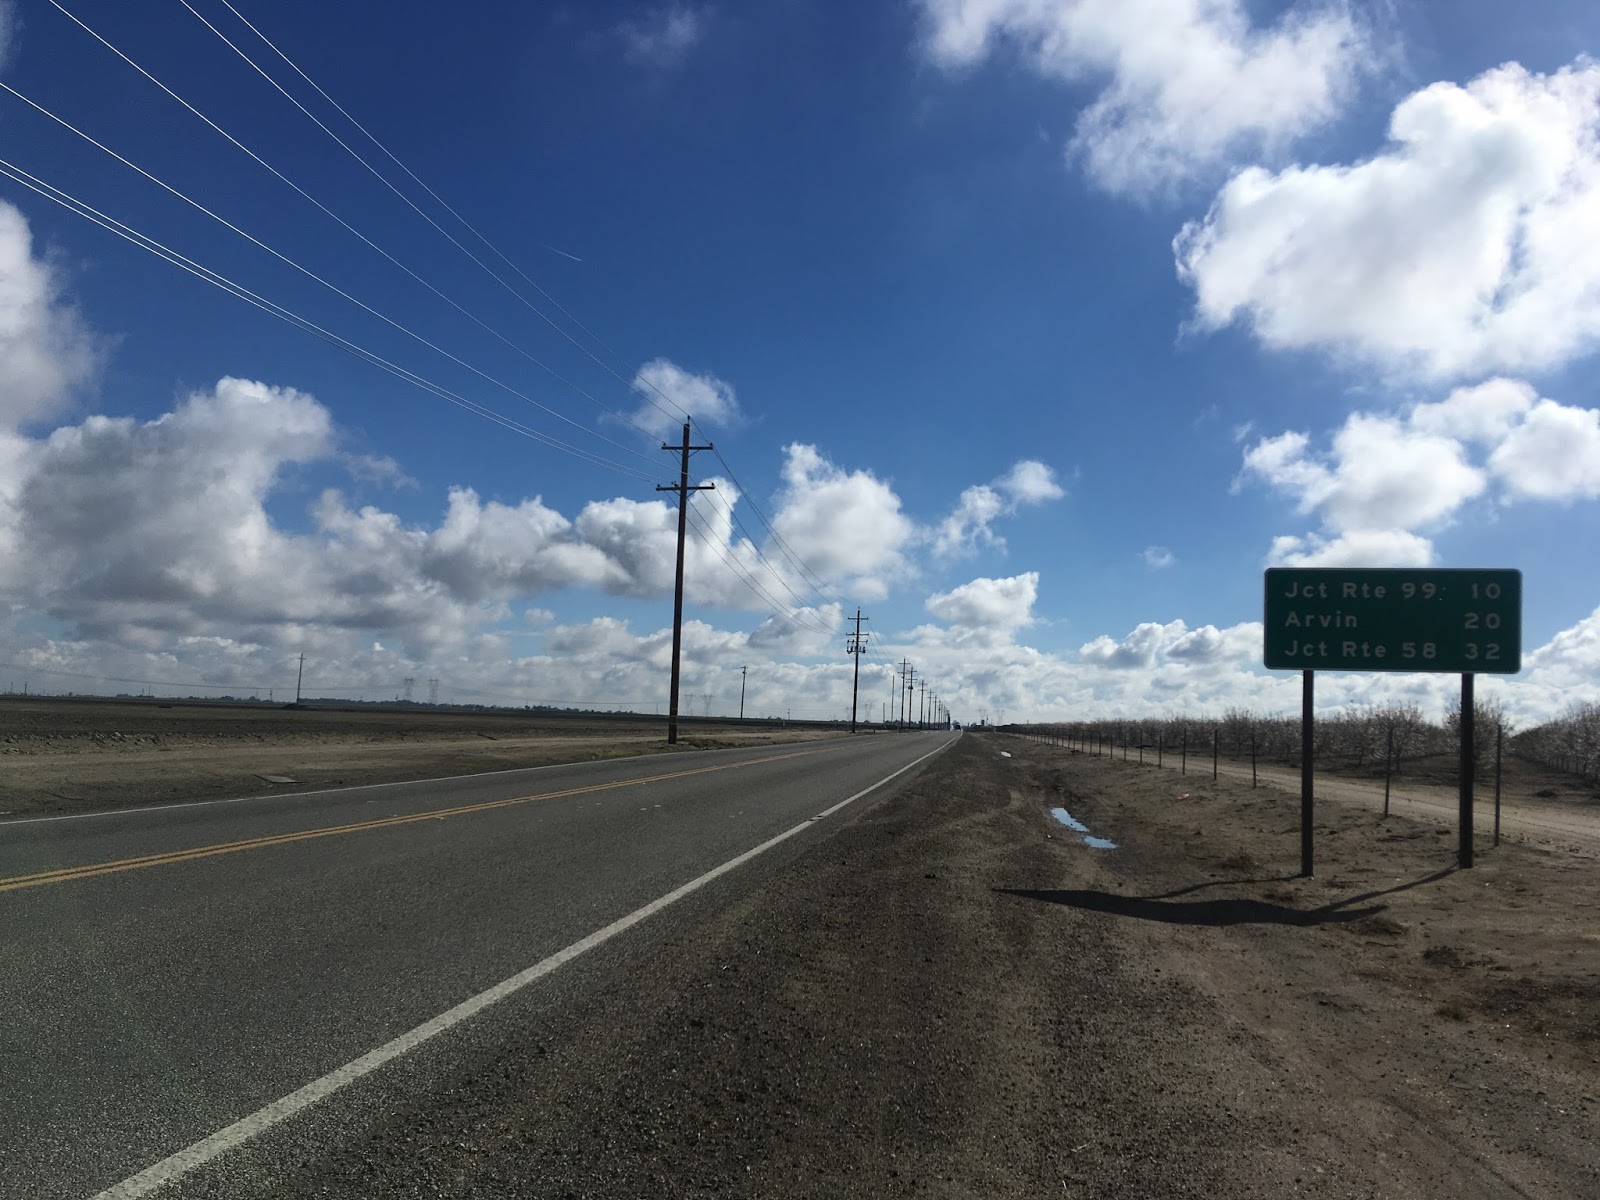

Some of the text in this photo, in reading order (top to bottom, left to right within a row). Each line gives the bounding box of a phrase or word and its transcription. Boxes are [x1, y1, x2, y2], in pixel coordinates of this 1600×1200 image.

[1284, 582, 1501, 599] Jct Rte 99 10
[1284, 610, 1501, 629] Arvin 20
[1284, 640, 1501, 660] Jct Rte 58 32
